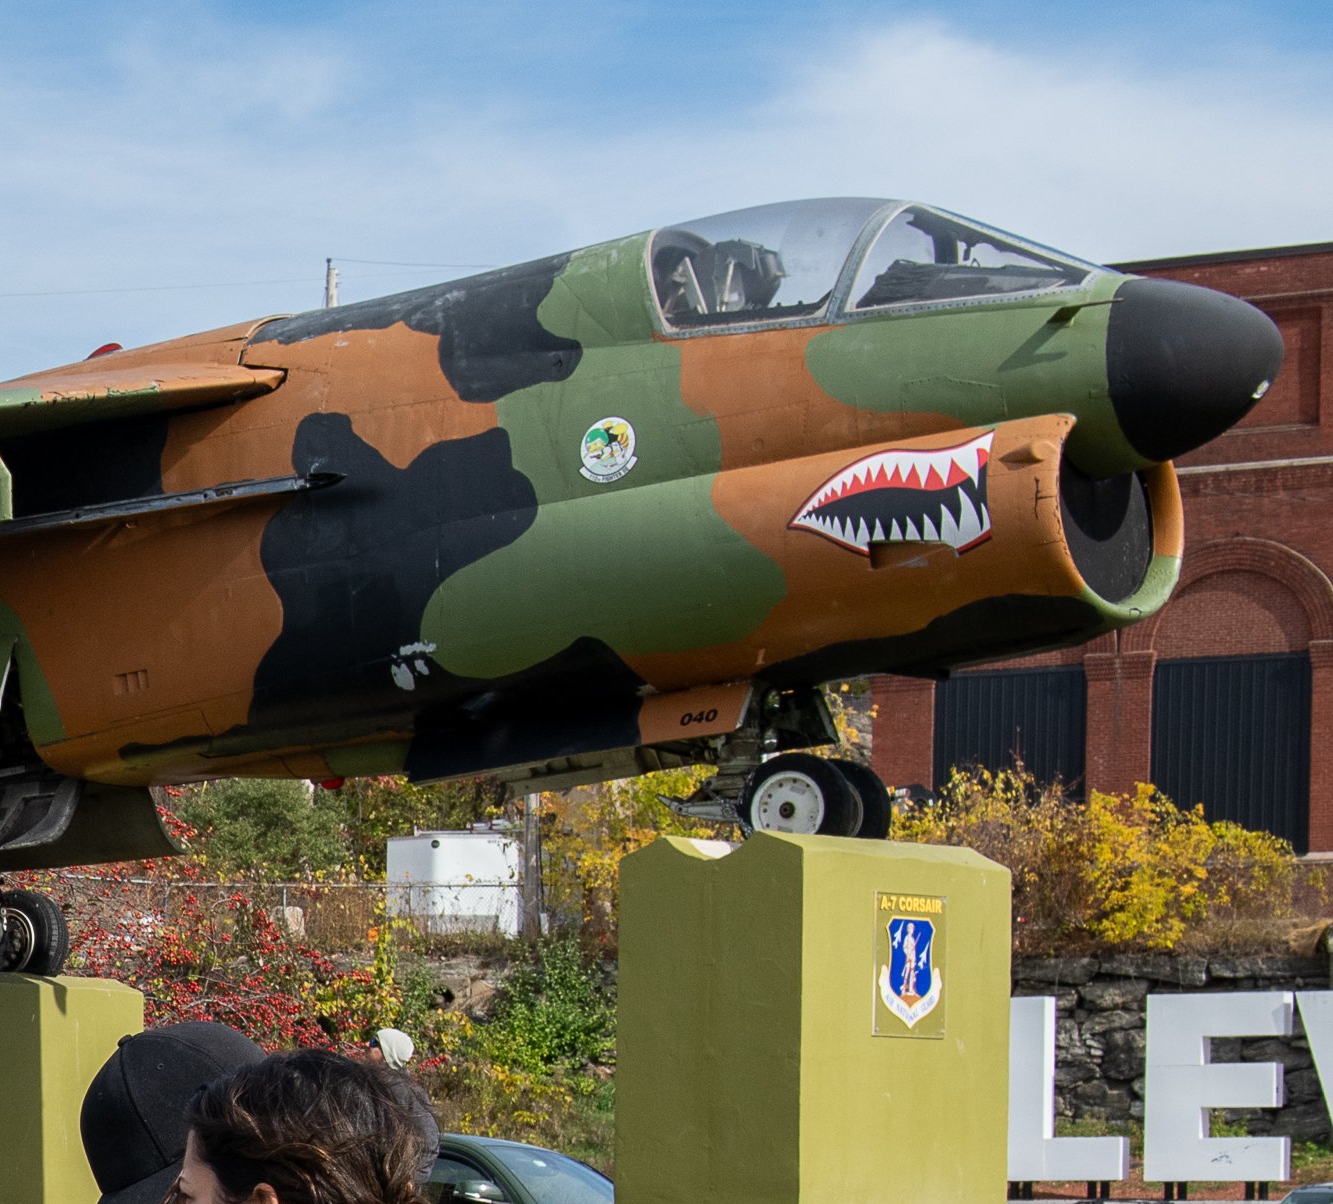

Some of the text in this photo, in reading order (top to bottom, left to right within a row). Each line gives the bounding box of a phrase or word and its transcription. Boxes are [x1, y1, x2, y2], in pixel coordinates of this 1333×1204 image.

[680, 708, 719, 727] 040
[881, 895, 943, 914] A-7 CORSAIR
